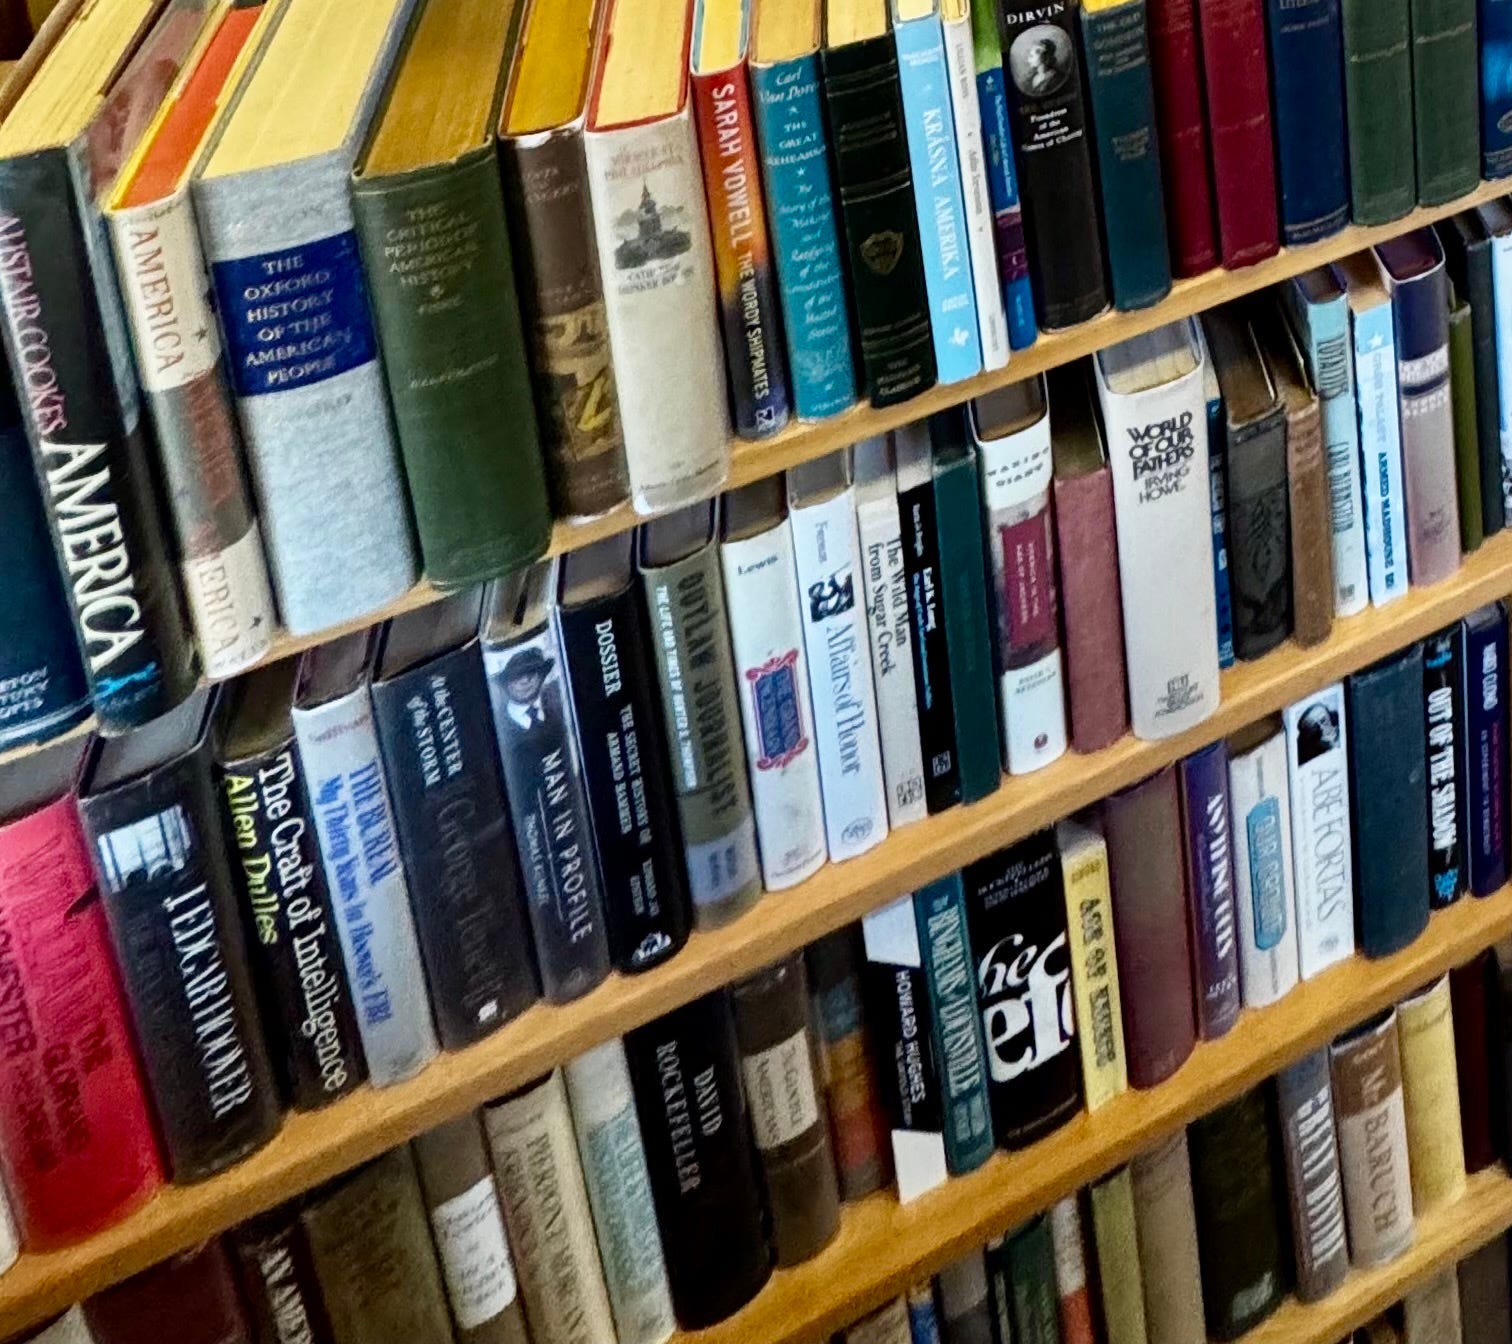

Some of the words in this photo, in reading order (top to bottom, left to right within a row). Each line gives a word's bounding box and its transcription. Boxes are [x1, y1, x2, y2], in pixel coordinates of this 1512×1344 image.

[1006, 0, 1066, 26] DIRVIN
[711, 83, 745, 164] SARAH
[779, 132, 818, 150] GREAT
[720, 164, 753, 251] VOWELL
[262, 254, 304, 276] THE
[740, 249, 754, 277] THE
[934, 195, 961, 282] AMERIKA
[129, 225, 187, 372] AMERICA
[244, 268, 332, 300] OXFORD
[246, 288, 335, 323] HISTORY
[743, 276, 761, 329] WORDY
[244, 326, 354, 368] AMERICAN
[257, 324, 284, 342] OF
[287, 311, 333, 336] THE
[266, 355, 338, 387] PEOPLE
[748, 328, 770, 401] SHIPMATES
[1126, 410, 1194, 444] WORLD
[1129, 442, 1154, 462] OF
[1154, 429, 1195, 453] OUR
[1132, 443, 1196, 482] FATHERS
[1143, 464, 1192, 491] IRVING
[1376, 451, 1393, 498] ARMED
[41, 441, 145, 673] AMERICA
[886, 536, 904, 567] The
[1379, 498, 1396, 569] MADHOUSE
[736, 553, 780, 576] Lewis
[867, 542, 881, 582] from
[889, 567, 908, 608] Wild
[867, 582, 888, 626] Sugar
[893, 610, 909, 647] Man
[595, 617, 624, 699] DOSSIER
[825, 622, 857, 694] Affairs
[876, 626, 898, 678] Creek
[1427, 686, 1453, 724] OUT
[416, 725, 442, 789] STORM
[436, 707, 465, 777] CENTER
[839, 711, 869, 778] Honor
[1428, 722, 1455, 747] OF
[259, 751, 293, 820] The
[540, 752, 571, 806] MAN
[1429, 745, 1456, 786] THE
[1311, 768, 1343, 821] ABE
[553, 812, 576, 836] IN
[222, 773, 257, 850] Allen
[242, 852, 282, 945] Dulles
[270, 817, 314, 900] Craft
[1312, 822, 1347, 923] FORTAS
[286, 884, 323, 925] of
[554, 842, 594, 944] PROFILE
[169, 906, 230, 1010] EDGAR
[293, 923, 349, 1093] Intelligence
[895, 970, 915, 1042] HOWARD
[190, 999, 254, 1120] HOOVER
[903, 1040, 926, 1104] HUGHES
[656, 1039, 702, 1196] ROCKEFELLER
[693, 1063, 723, 1138] DAVID
[1365, 1109, 1400, 1236] BARUCH
